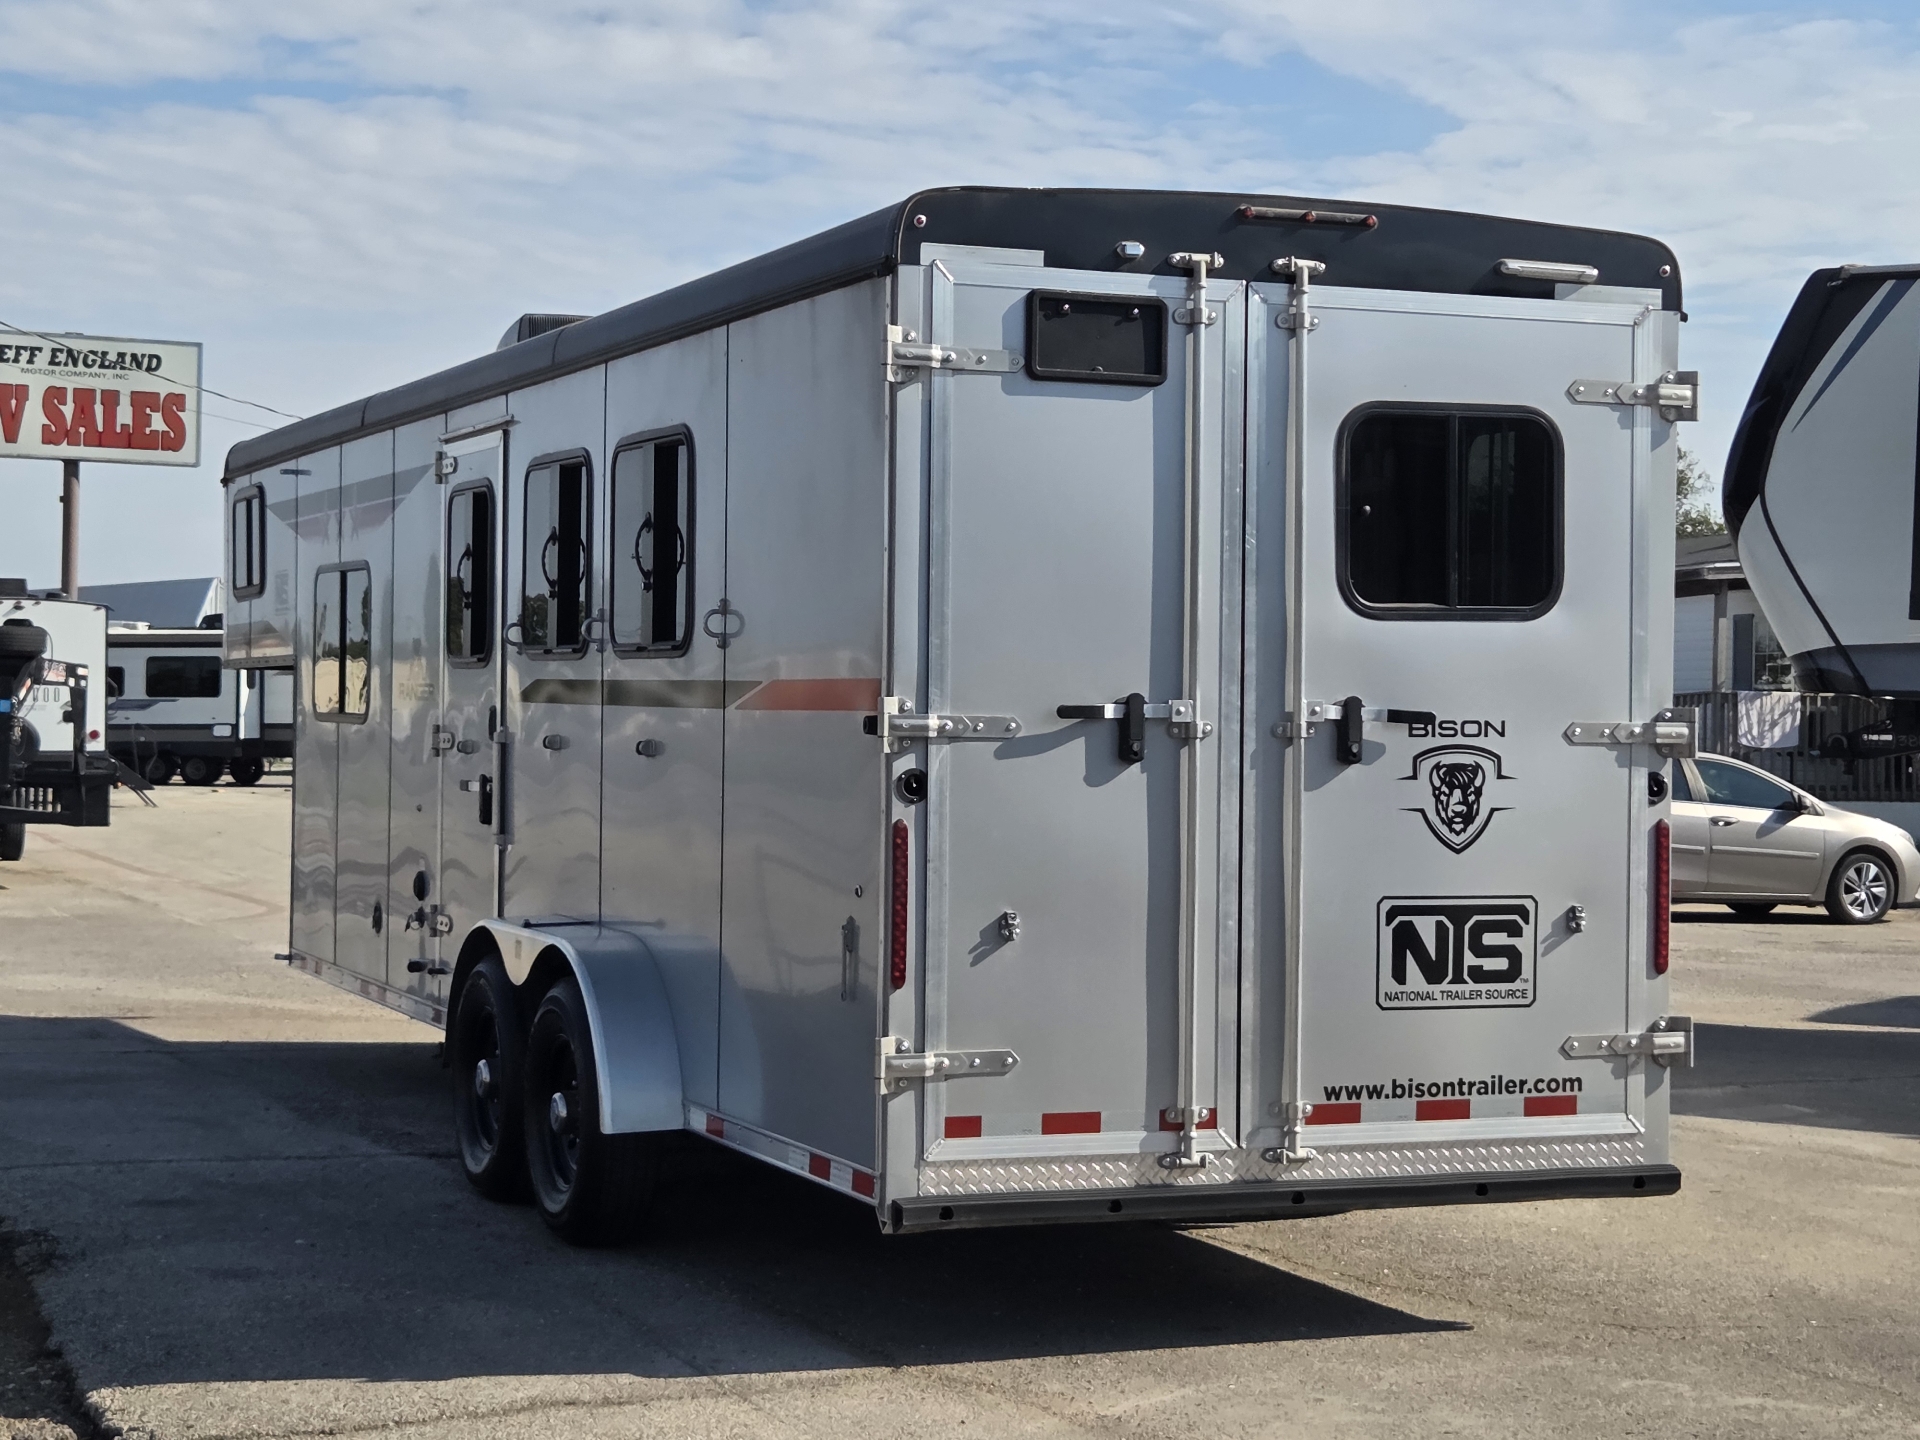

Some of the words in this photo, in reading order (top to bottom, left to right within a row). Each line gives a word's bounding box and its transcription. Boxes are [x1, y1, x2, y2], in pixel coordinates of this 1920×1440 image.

[21, 367, 56, 376] MOTOR
[48, 347, 162, 372] ENGLAND
[42, 386, 187, 452] SALES
[1408, 720, 1505, 737] BISON
[1385, 904, 1530, 985] NTS
[1384, 990, 1438, 1002] NATIONAL
[1439, 989, 1483, 1000] TRAILER
[1484, 988, 1529, 1000] SOURCE
[1323, 1075, 1583, 1101] www.bisontrailer.com
